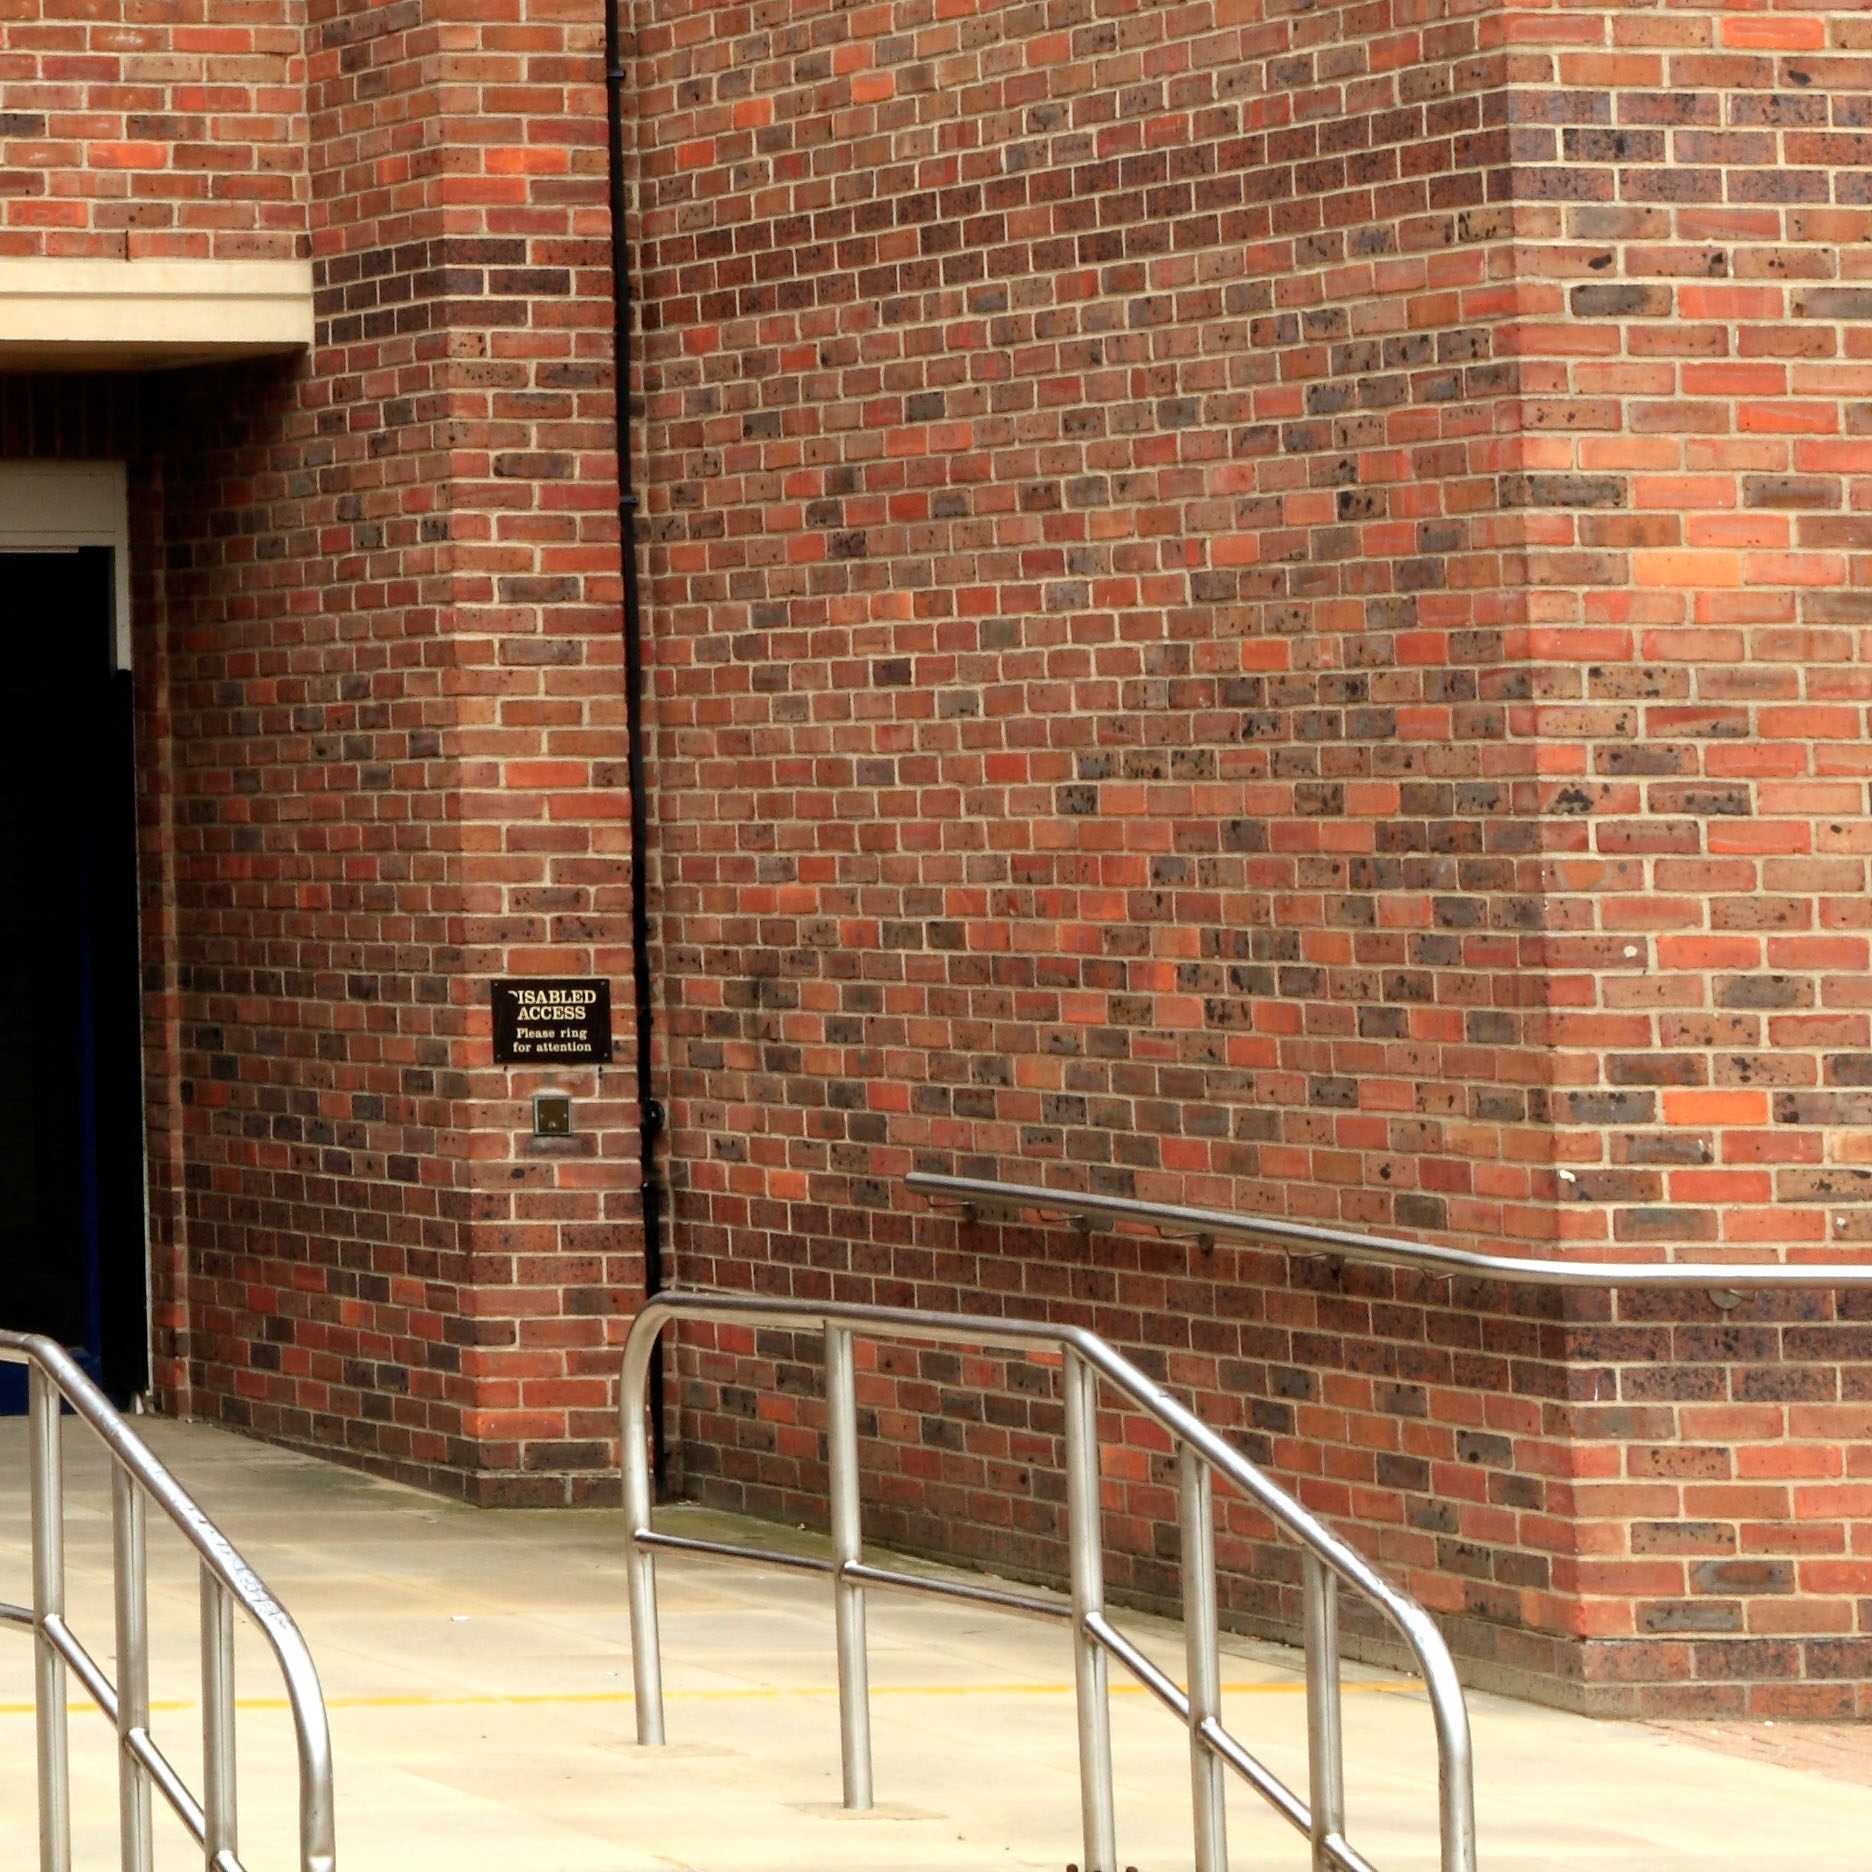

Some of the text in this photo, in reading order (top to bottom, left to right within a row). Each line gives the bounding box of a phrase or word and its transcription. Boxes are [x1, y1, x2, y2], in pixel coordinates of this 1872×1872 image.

[517, 1006, 587, 1021] ACCESS
[516, 1027, 588, 1040] Please ring
[512, 1041, 592, 1053] for attention
